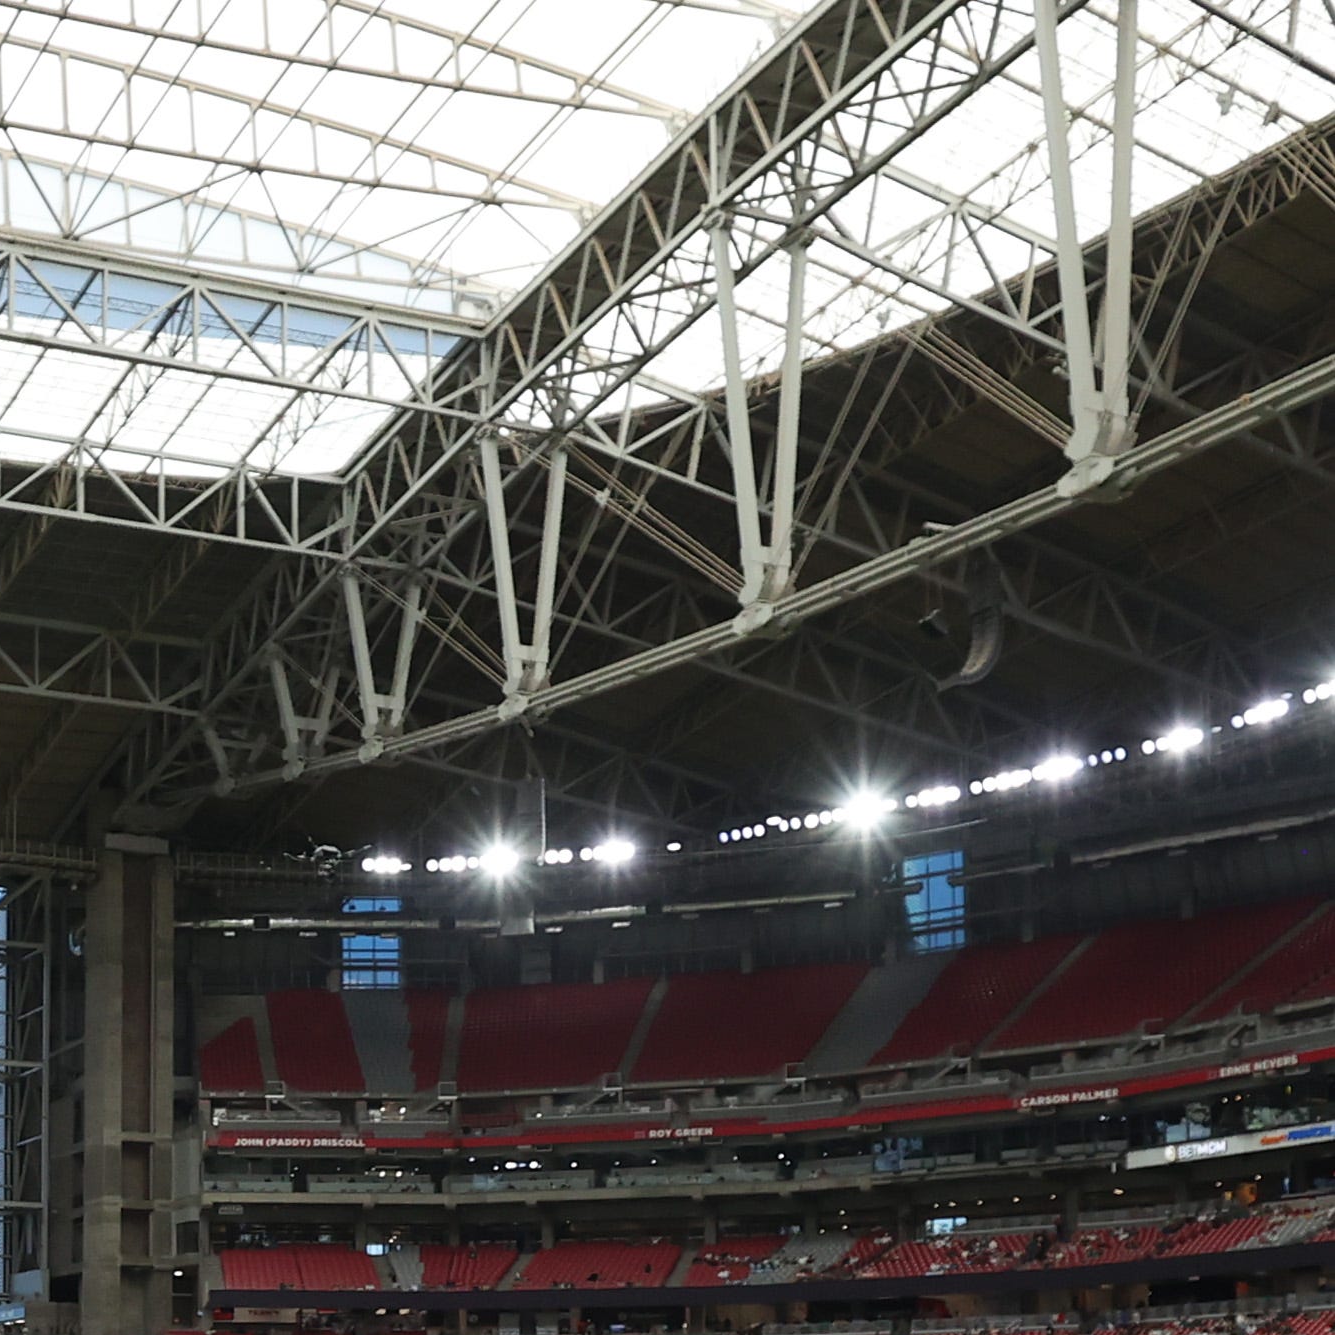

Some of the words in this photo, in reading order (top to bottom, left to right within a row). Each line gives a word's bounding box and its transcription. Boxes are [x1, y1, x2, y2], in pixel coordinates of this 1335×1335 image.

[1021, 1092, 1070, 1107] CARSON
[1071, 1088, 1119, 1102] PALMER
[649, 1129, 674, 1138] ROY
[675, 1127, 714, 1137] GREEN
[235, 1138, 264, 1147] JOHN
[266, 1138, 311, 1147] (PADDY)
[312, 1138, 366, 1147] DRISCOLL
